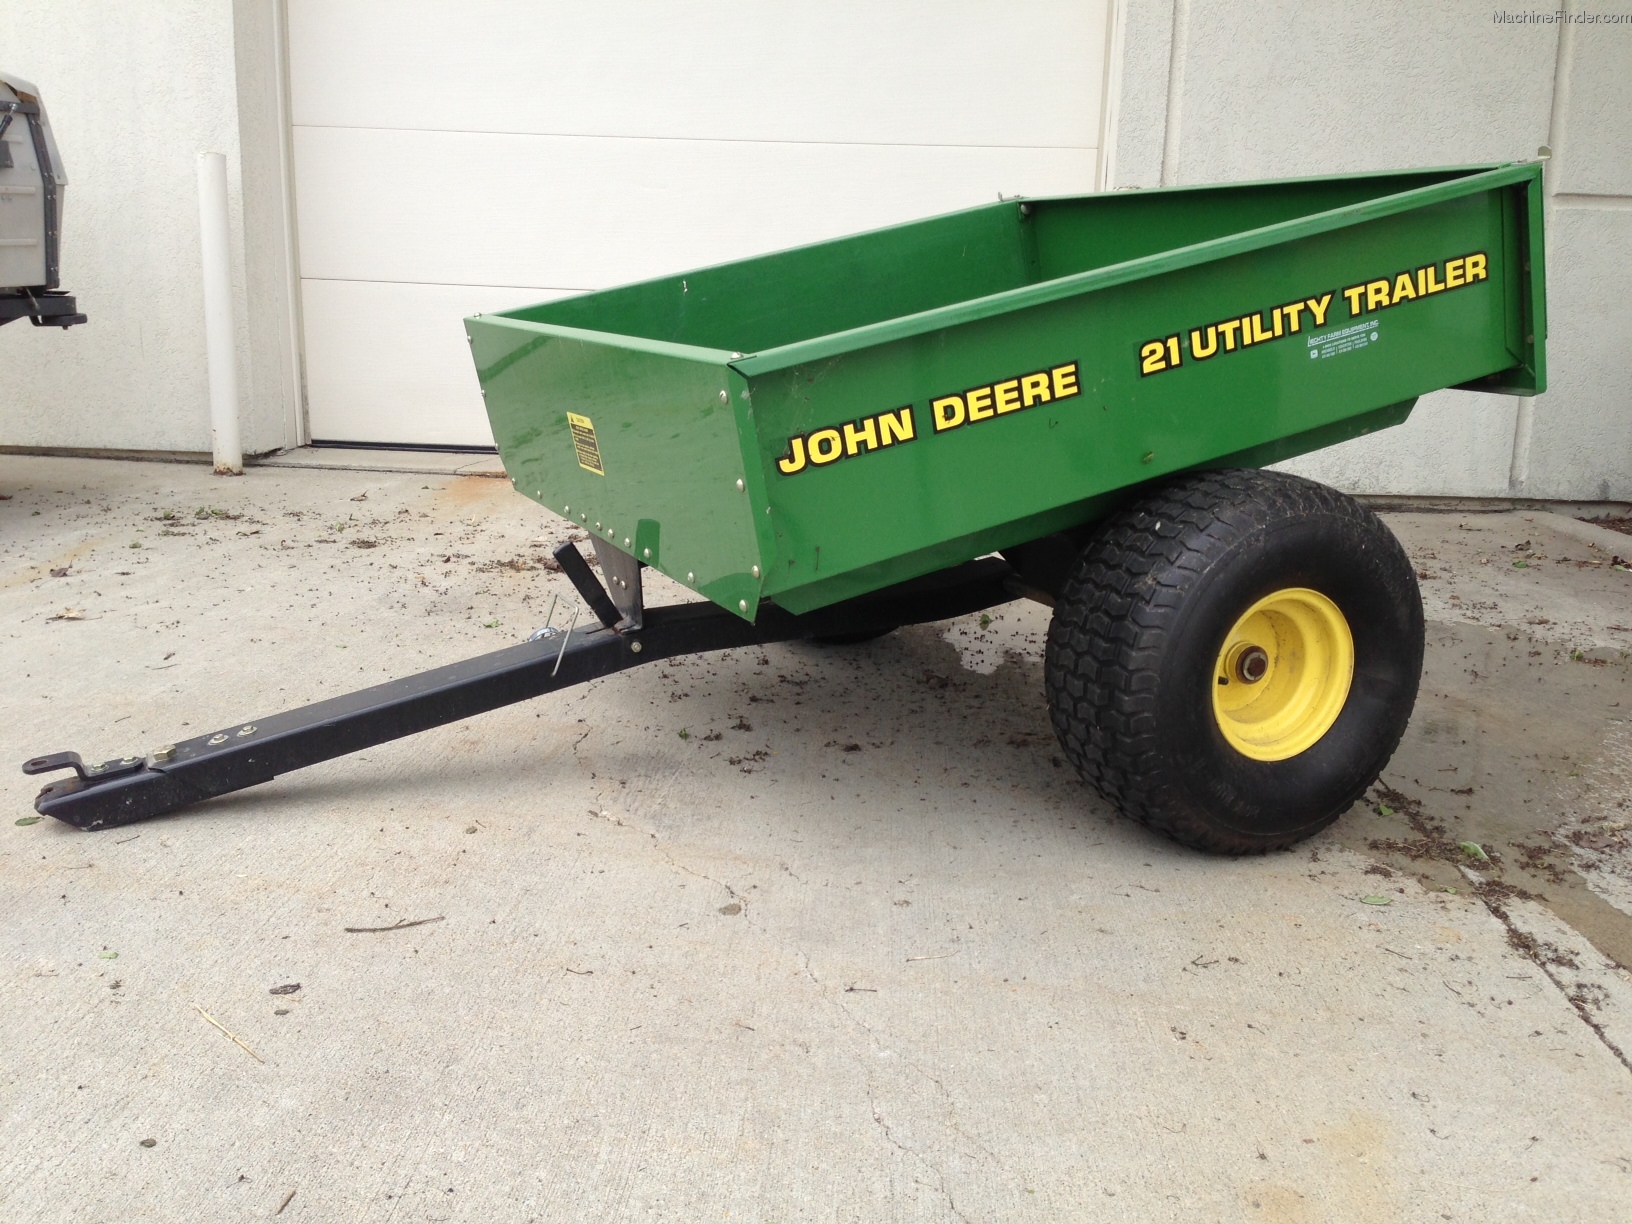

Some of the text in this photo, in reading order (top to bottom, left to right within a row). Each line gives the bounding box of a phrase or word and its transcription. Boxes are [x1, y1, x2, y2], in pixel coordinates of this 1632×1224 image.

[775, 251, 1489, 477] JOHN DEERE 21 UTILITY TRAILER
